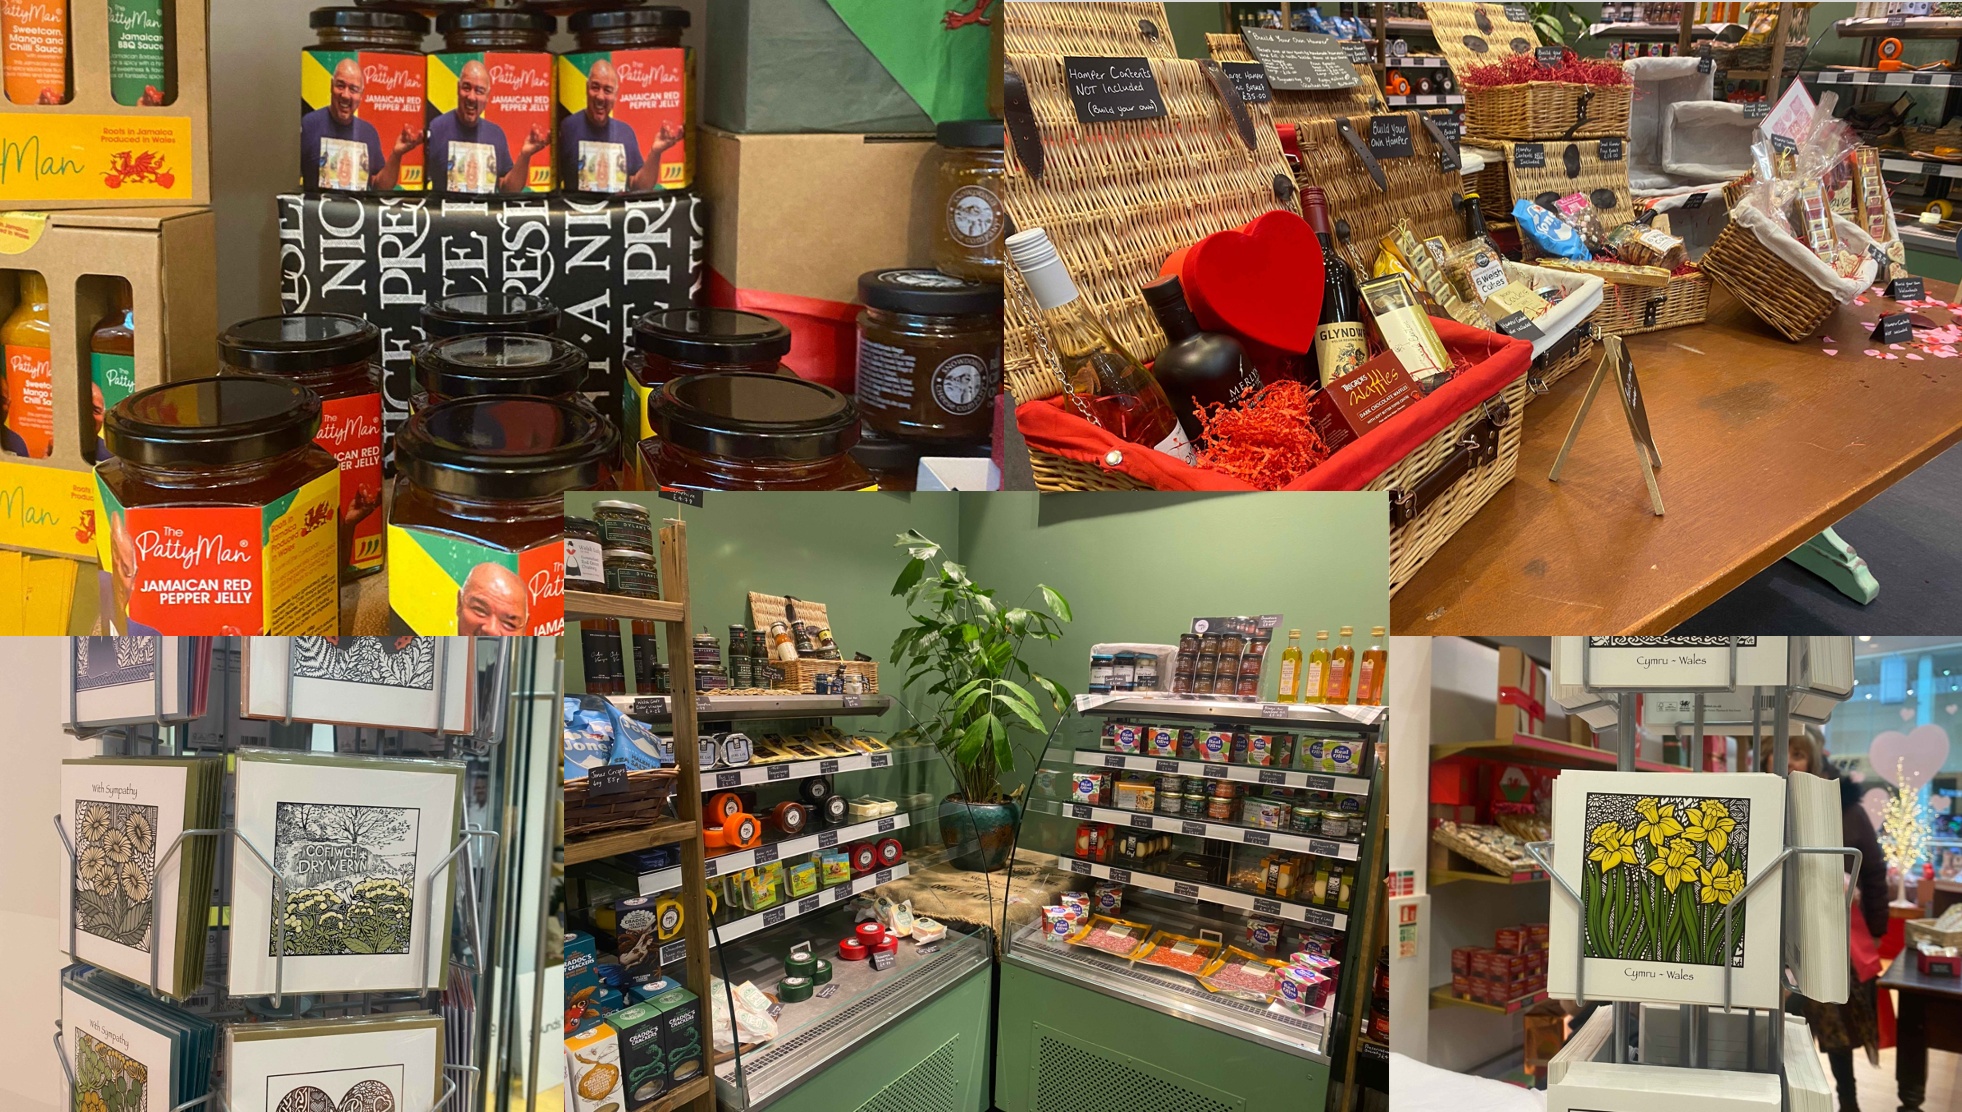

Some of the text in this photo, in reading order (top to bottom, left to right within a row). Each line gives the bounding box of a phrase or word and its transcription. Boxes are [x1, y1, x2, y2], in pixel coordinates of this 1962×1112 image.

[9, 34, 43, 45] Mango
[118, 41, 164, 50] BBQ Sauce
[9, 43, 63, 54] Chilli Sauce
[1069, 66, 1151, 80] Hamper Contents
[1076, 82, 1144, 95] NOT Included
[365, 95, 421, 104] JAMAICAN RED
[491, 95, 549, 104] JAMAICAN RED
[620, 91, 680, 102] JAMAICAN RED
[374, 103, 421, 112] PEPPER JELLY
[500, 103, 549, 112] PEPPER JELLY
[629, 99, 680, 110] PEPPER JELLY
[1118, 106, 1135, 116] your
[137, 128, 173, 136] Jamaica
[1372, 121, 1389, 135] Build
[152, 136, 176, 144] Wales
[1385, 137, 1408, 147] Hamper
[1830, 197, 1850, 207] ove
[1476, 268, 1504, 286] 6 Welsh
[1482, 278, 1505, 293] Cakes
[23, 388, 48, 398] Mango
[1350, 368, 1399, 406] Waffles
[23, 396, 41, 404] Chilli
[1360, 409, 1372, 418] DARK
[1371, 394, 1393, 411] CHOCOLATE
[316, 415, 380, 446] attyMan
[361, 446, 380, 457] RED
[354, 456, 380, 468] JELLY
[163, 526, 183, 537] The
[553, 561, 564, 572] Th
[140, 579, 252, 592] JAMAICAN RED
[160, 592, 252, 605] PEPPER JELLY
[1636, 653, 1707, 669] Cymru Wales
[563, 740, 609, 752] Jone
[92, 784, 138, 800] With Sympathy
[306, 845, 357, 857] COFIWCH
[298, 859, 367, 873] DRYWERYN
[564, 953, 592, 967] RADOC'S
[1624, 967, 1694, 981] Cymru Wales
[668, 1010, 696, 1024] CRADOC'S
[671, 1015, 695, 1028] CRACKERS
[90, 1019, 129, 1051] With Sympathy
[629, 1026, 659, 1043] CRADOC'S
[631, 1033, 657, 1046] CRACKERS
